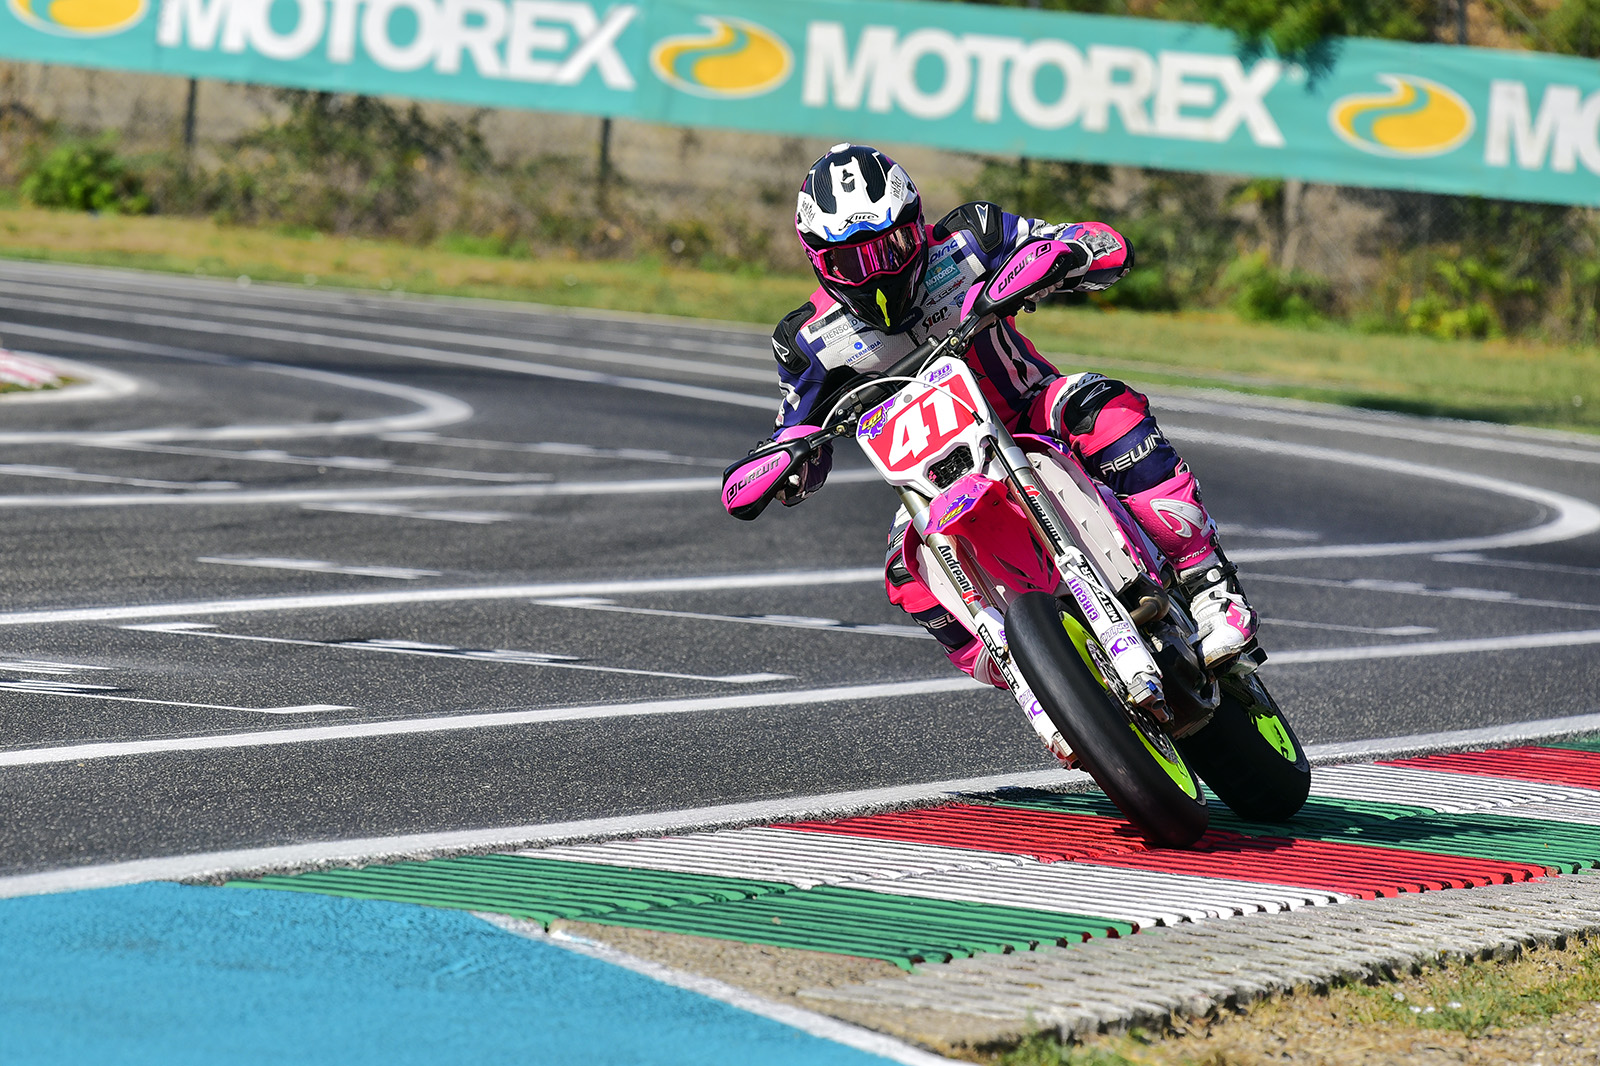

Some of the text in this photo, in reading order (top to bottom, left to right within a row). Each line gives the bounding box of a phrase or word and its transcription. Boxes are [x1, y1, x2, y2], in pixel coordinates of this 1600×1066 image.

[156, 0, 637, 91] MOTOREX
[802, 20, 1287, 148] MOTOREX
[925, 263, 957, 287] MOTOREX
[822, 319, 862, 341] HENSOLD
[846, 340, 881, 363] INTERMEDIA
[888, 383, 959, 467] 41
[938, 545, 974, 592] Andreani
[1068, 578, 1099, 621] CIRCUIT
[980, 625, 1015, 685] METELER
